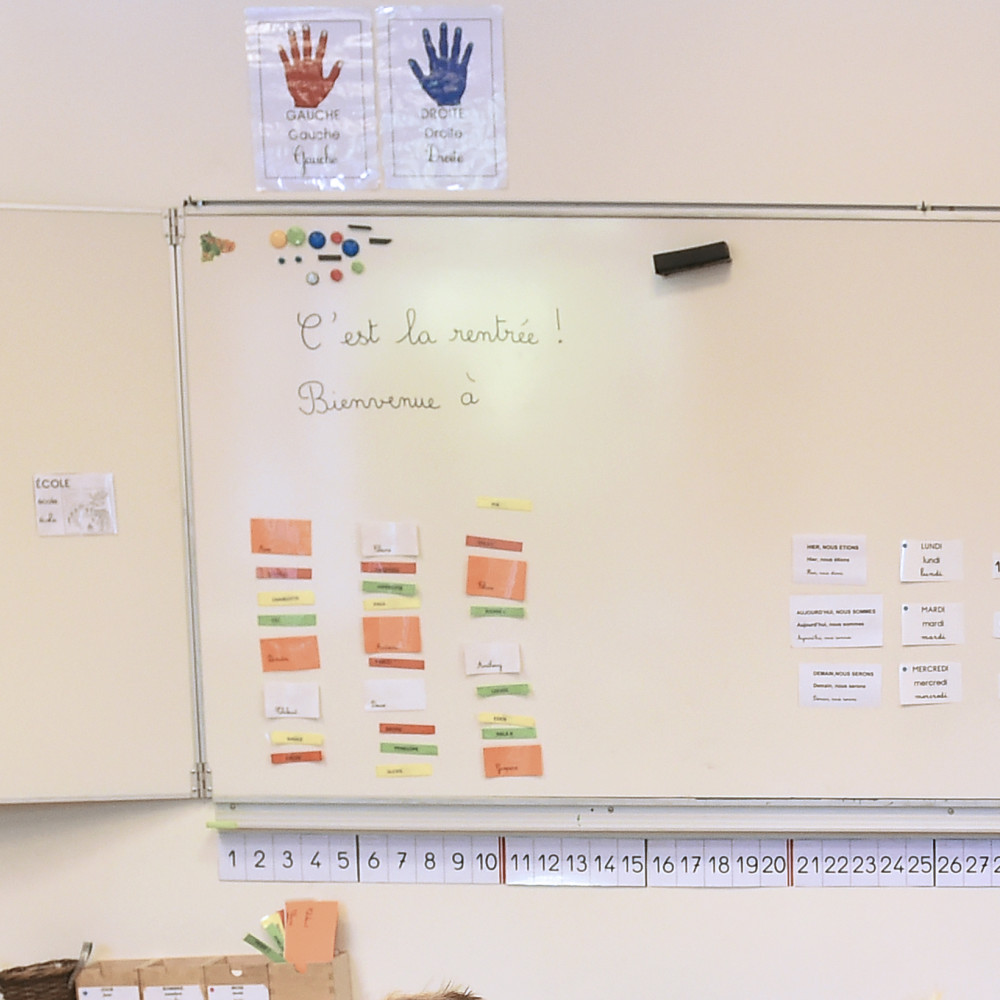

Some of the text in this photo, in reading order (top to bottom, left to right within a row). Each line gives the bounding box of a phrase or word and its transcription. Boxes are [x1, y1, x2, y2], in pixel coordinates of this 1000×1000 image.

[286, 109, 340, 121] GAUCHE
[288, 128, 340, 142] Gauche
[297, 308, 564, 350] C'est la rentrée !
[298, 371, 480, 415] Bienvenue à
[922, 556, 940, 564] lundi
[995, 560, 1000, 573] 1
[922, 619, 944, 627] mardi
[912, 665, 949, 673] MERCREDI
[914, 679, 948, 687] mercredi
[228, 850, 236, 867] 1
[254, 850, 266, 868] 2
[282, 850, 294, 868] 3
[310, 851, 321, 868] 4
[337, 851, 350, 869] 5
[367, 851, 380, 869] 6
[397, 851, 407, 869] 7
[424, 852, 436, 870] 8
[451, 852, 464, 870] 9
[475, 853, 498, 871] 10
[510, 854, 530, 871] 11
[538, 854, 560, 872] 12
[566, 854, 588, 872] 13
[594, 855, 615, 873] 14
[622, 855, 643, 873] 15
[653, 855, 675, 874] 16
[680, 855, 701, 874] 17
[708, 855, 730, 874] 18
[736, 855, 758, 874] 19
[762, 855, 786, 874] 20
[797, 855, 820, 874] 21
[824, 855, 849, 874] 22
[852, 855, 876, 874] 23
[880, 855, 904, 874] 24
[908, 855, 932, 874] 25
[938, 855, 962, 874] 26
[966, 855, 989, 874] 27
